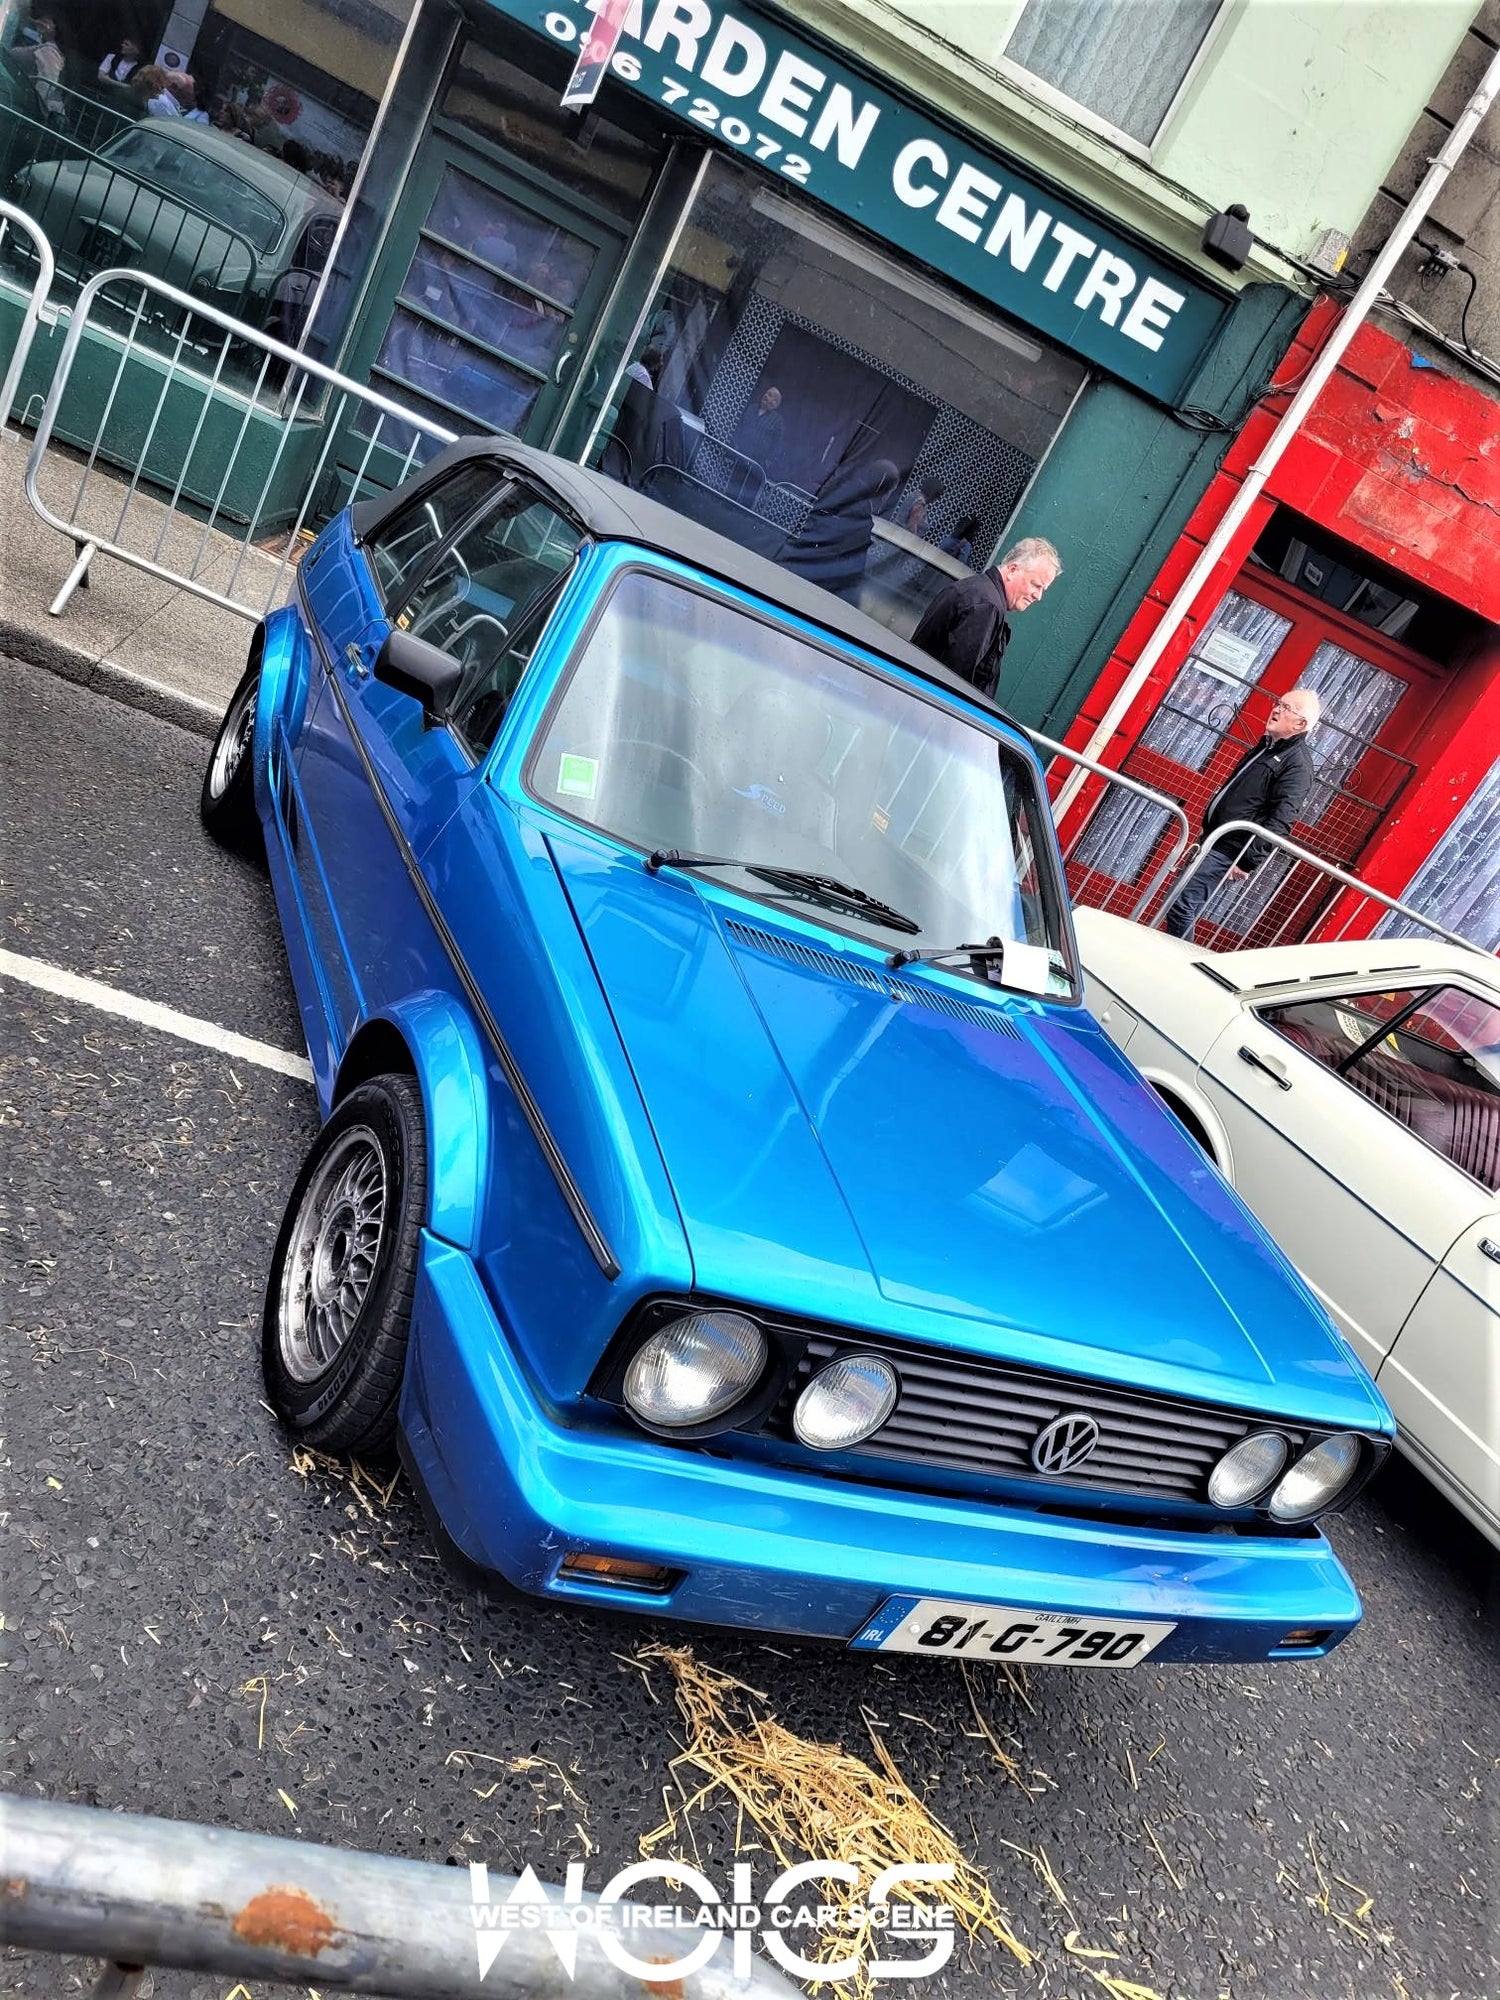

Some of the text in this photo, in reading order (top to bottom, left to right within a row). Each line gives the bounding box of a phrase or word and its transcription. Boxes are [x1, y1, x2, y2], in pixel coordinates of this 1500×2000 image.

[661, 76, 811, 184] 72072
[571, 0, 1185, 352] RDEN CENTRE
[1033, 1414, 1098, 1474] VW
[860, 1628, 883, 1642] IRL
[918, 1615, 1146, 1661] 81-G-790
